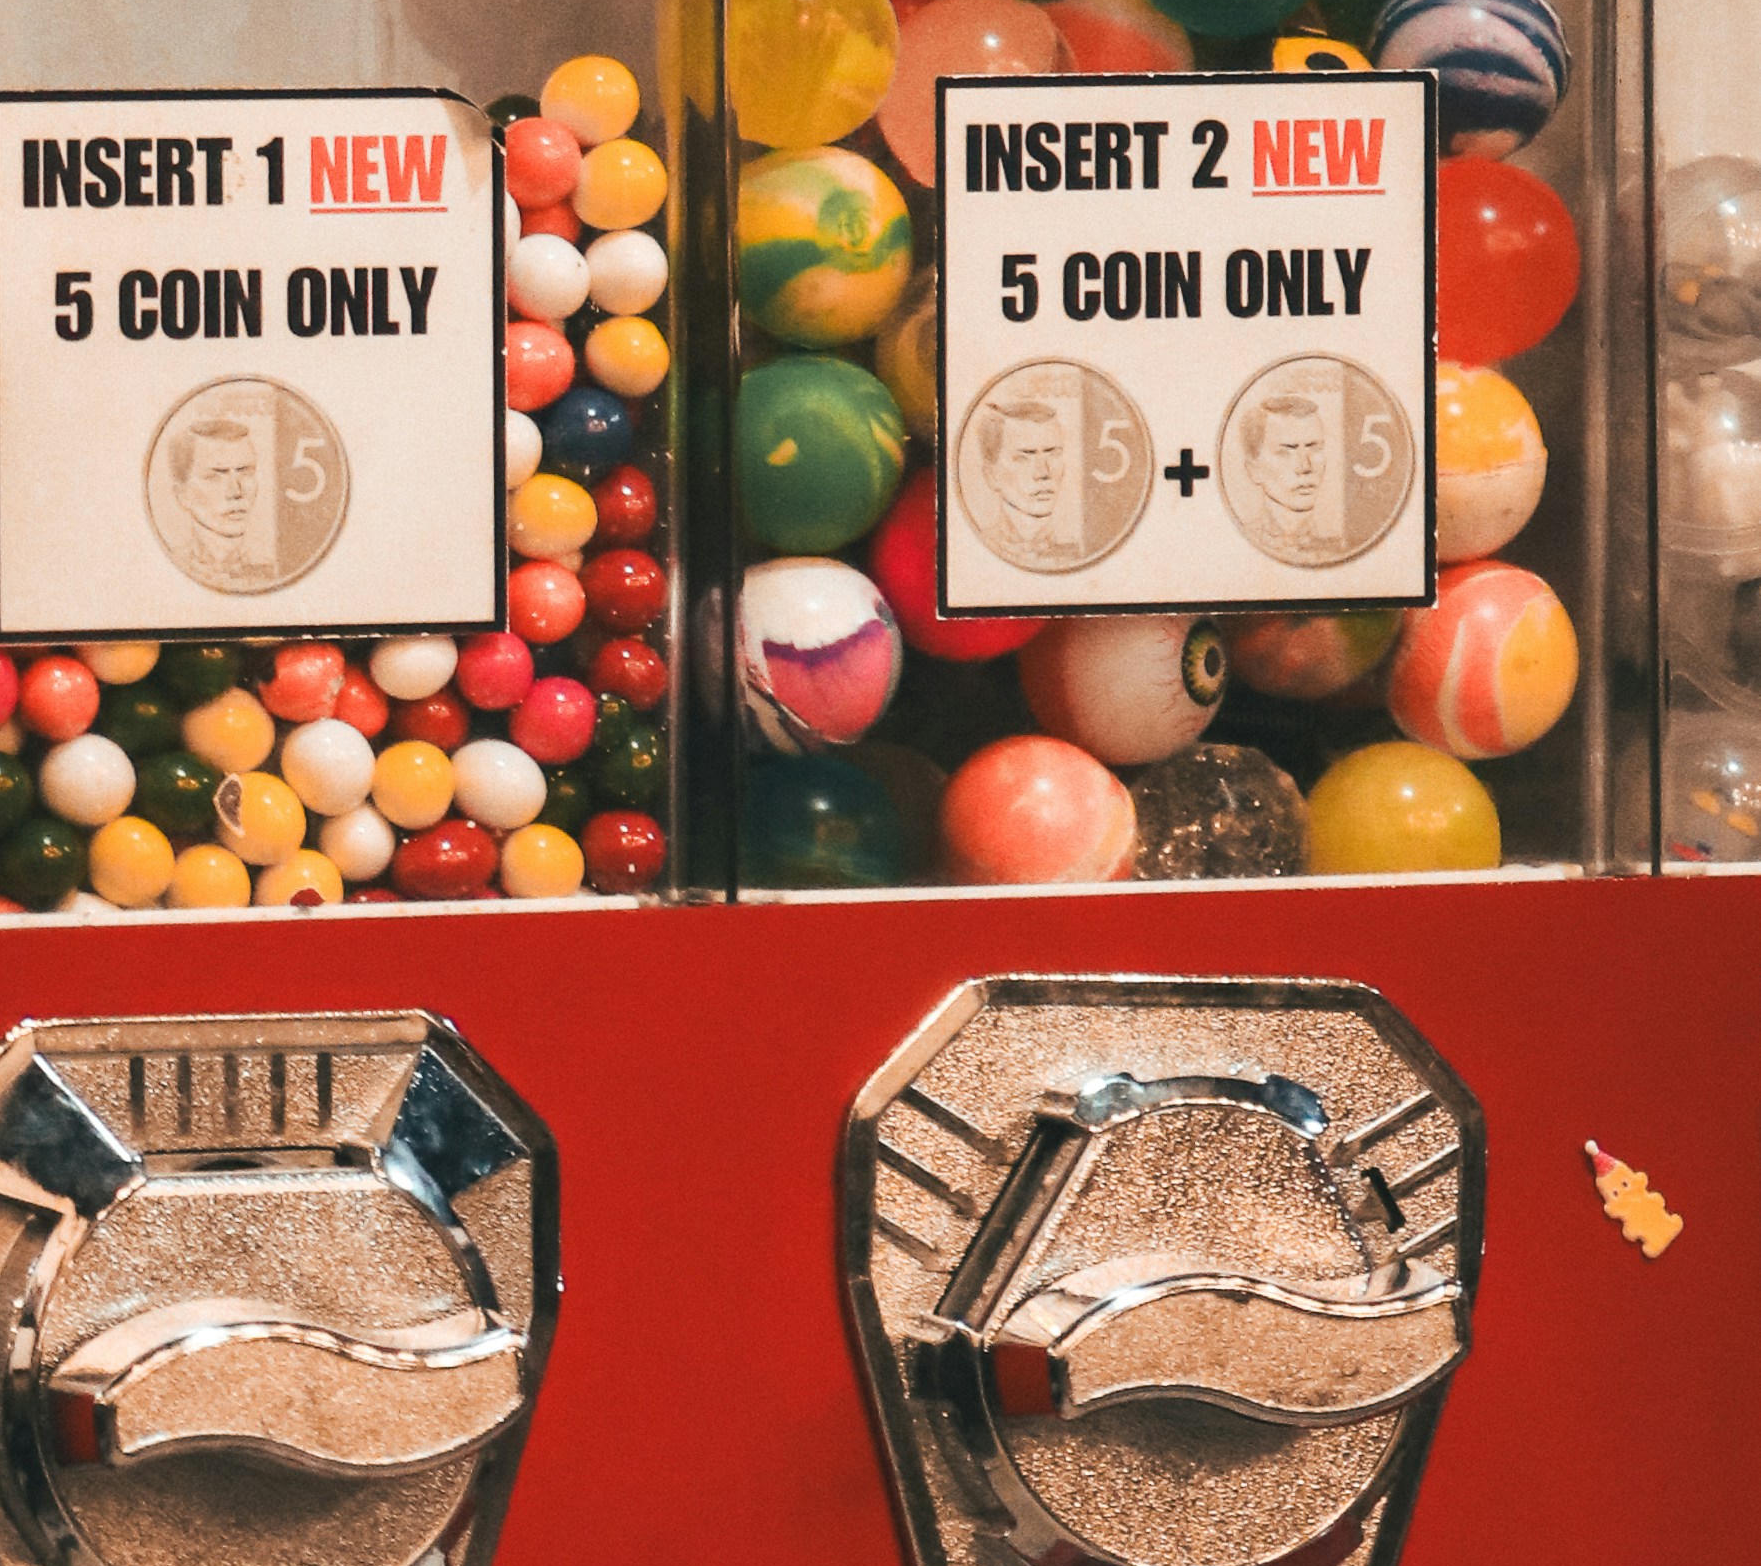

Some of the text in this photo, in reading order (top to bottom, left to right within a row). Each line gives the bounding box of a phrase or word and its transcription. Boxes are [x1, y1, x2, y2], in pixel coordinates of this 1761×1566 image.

[22, 134, 448, 209] INSERT 1 NEW
[965, 118, 1386, 193] INSERT 2 NEW
[54, 266, 439, 342] 5 COIN ONLY
[1001, 248, 1373, 323] 5 COIN ONLY
[285, 437, 326, 502] 5
[1091, 414, 1393, 498] 5 + 5
